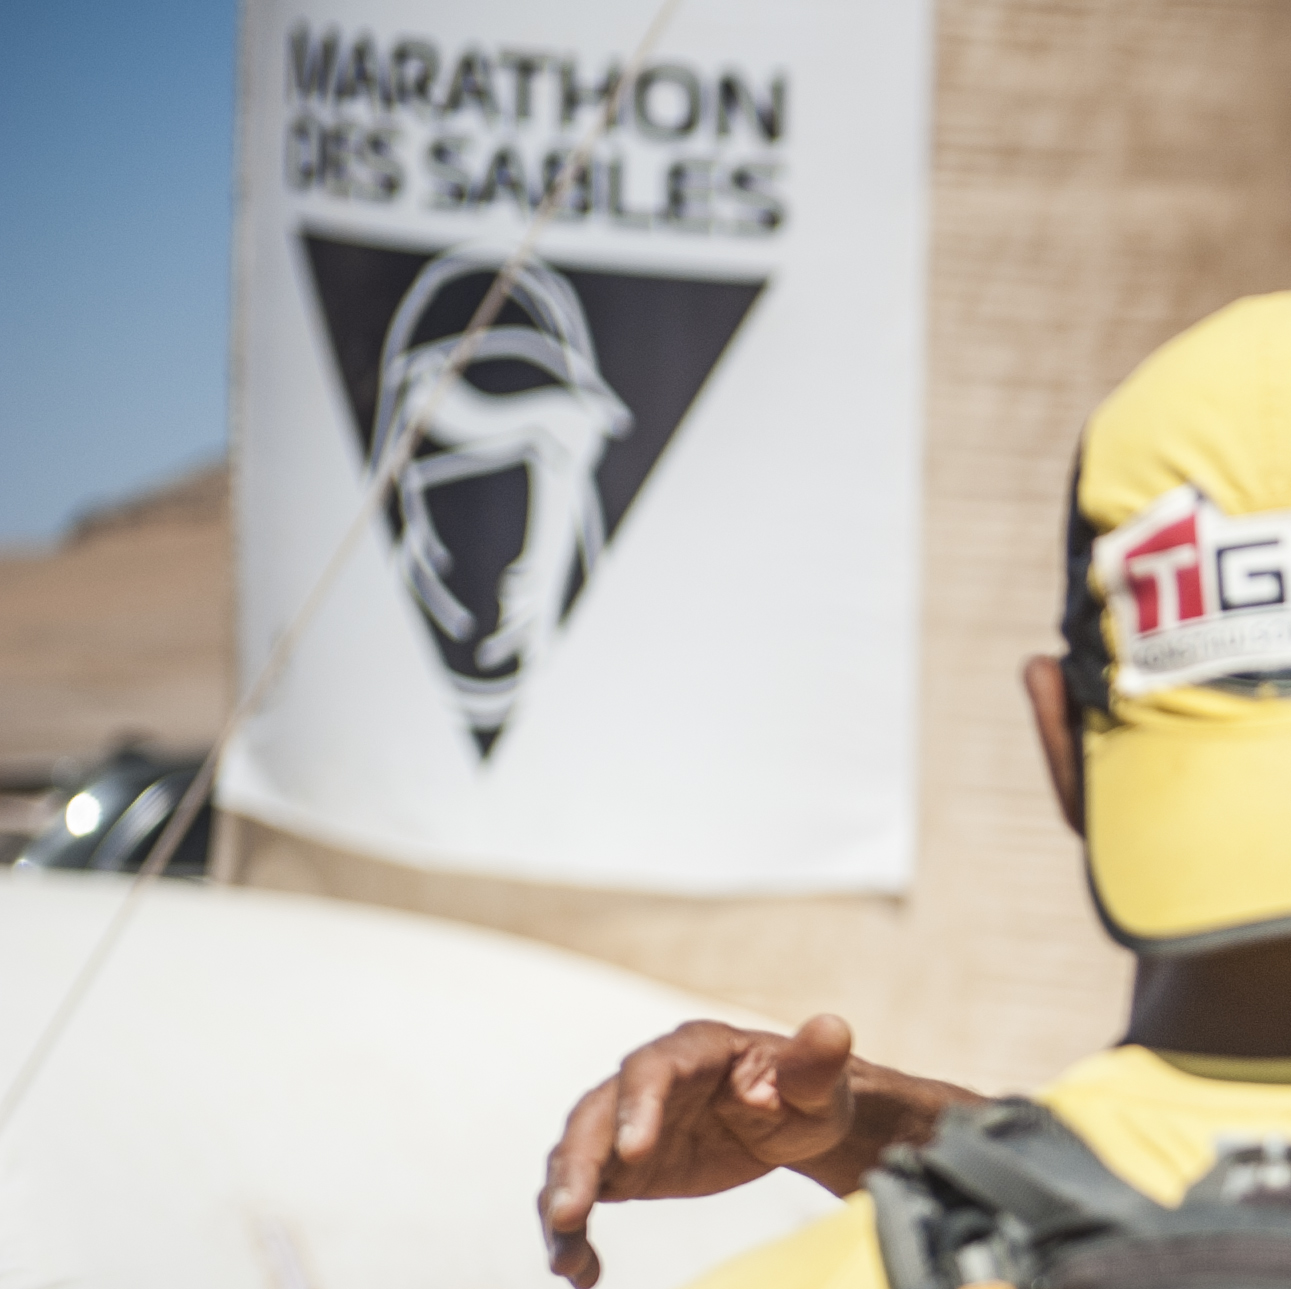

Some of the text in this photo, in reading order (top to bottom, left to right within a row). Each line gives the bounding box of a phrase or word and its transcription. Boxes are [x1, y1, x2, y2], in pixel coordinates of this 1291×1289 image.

[286, 18, 788, 143] MARATHON
[284, 113, 788, 238] DES SABLES
